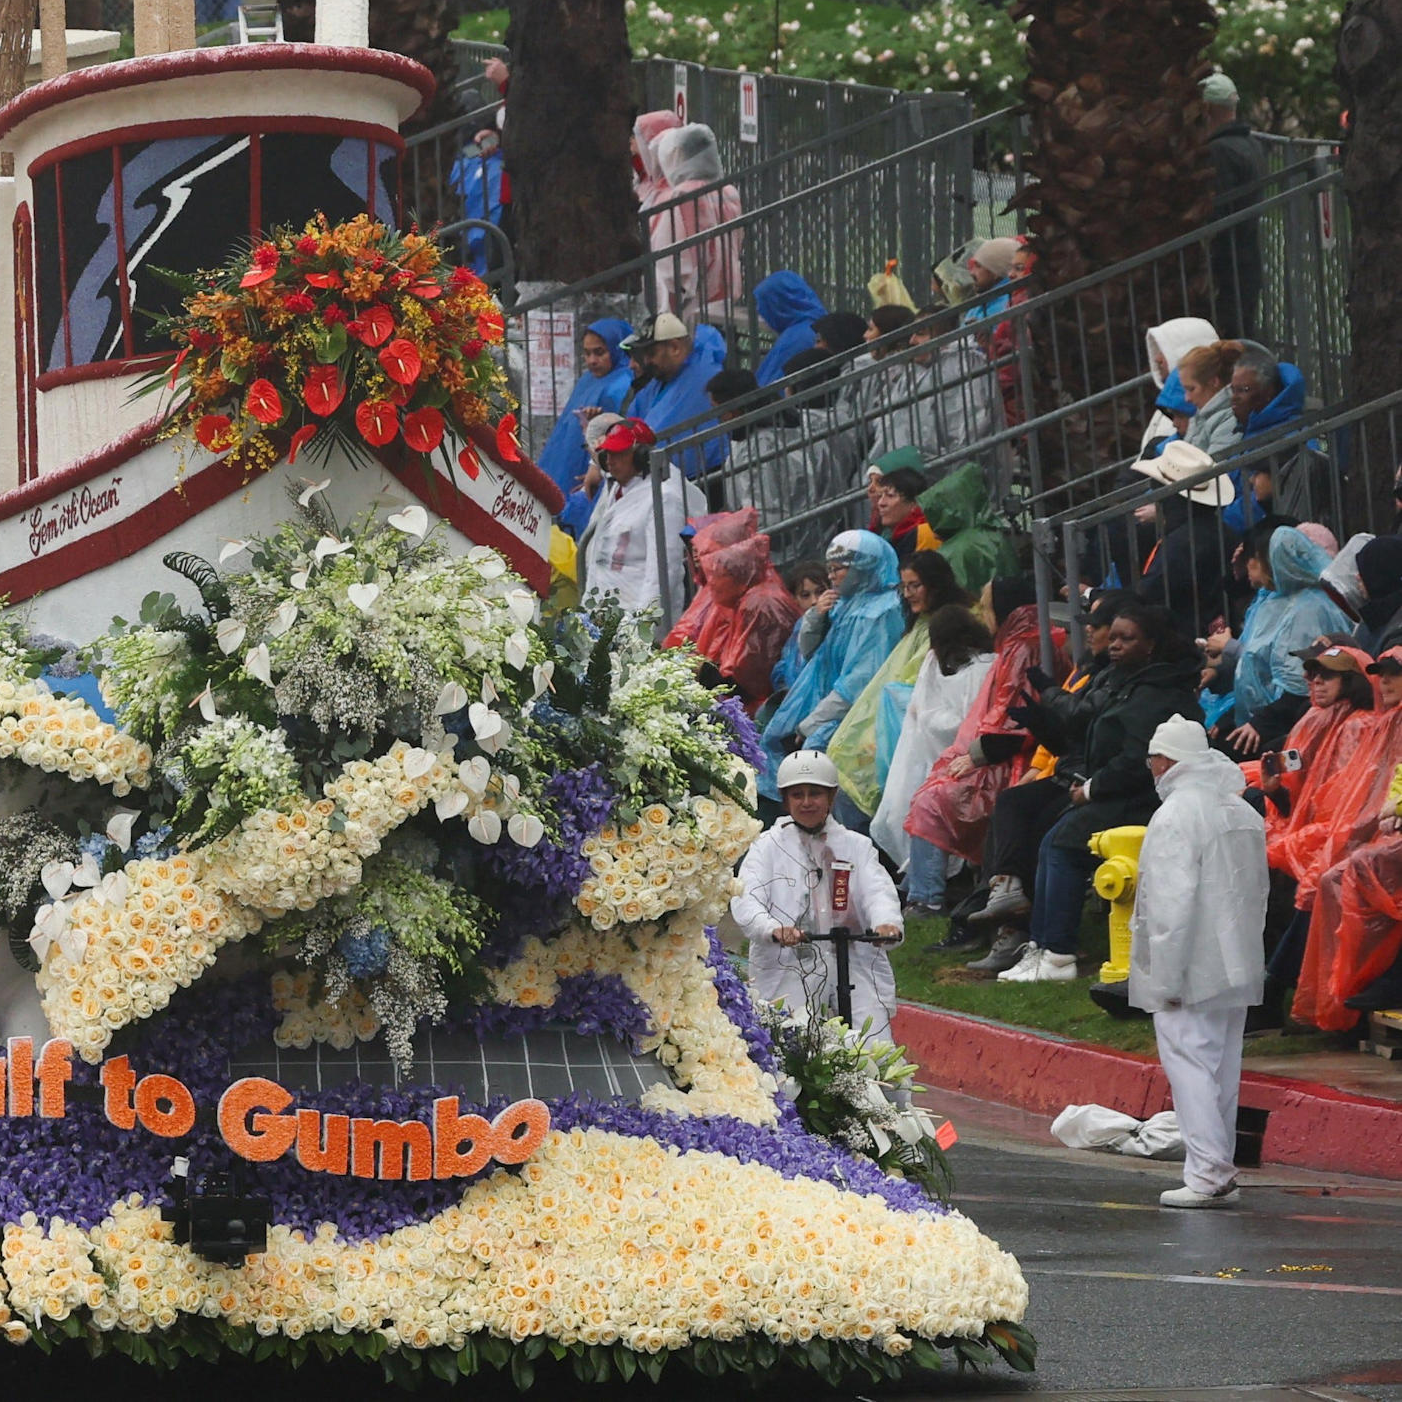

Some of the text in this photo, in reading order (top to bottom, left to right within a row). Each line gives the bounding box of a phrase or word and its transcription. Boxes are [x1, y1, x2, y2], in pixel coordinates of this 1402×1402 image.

[80, 486, 121, 524] Ocean
[99, 1054, 196, 1138] to
[218, 1076, 551, 1181] Gumbo
